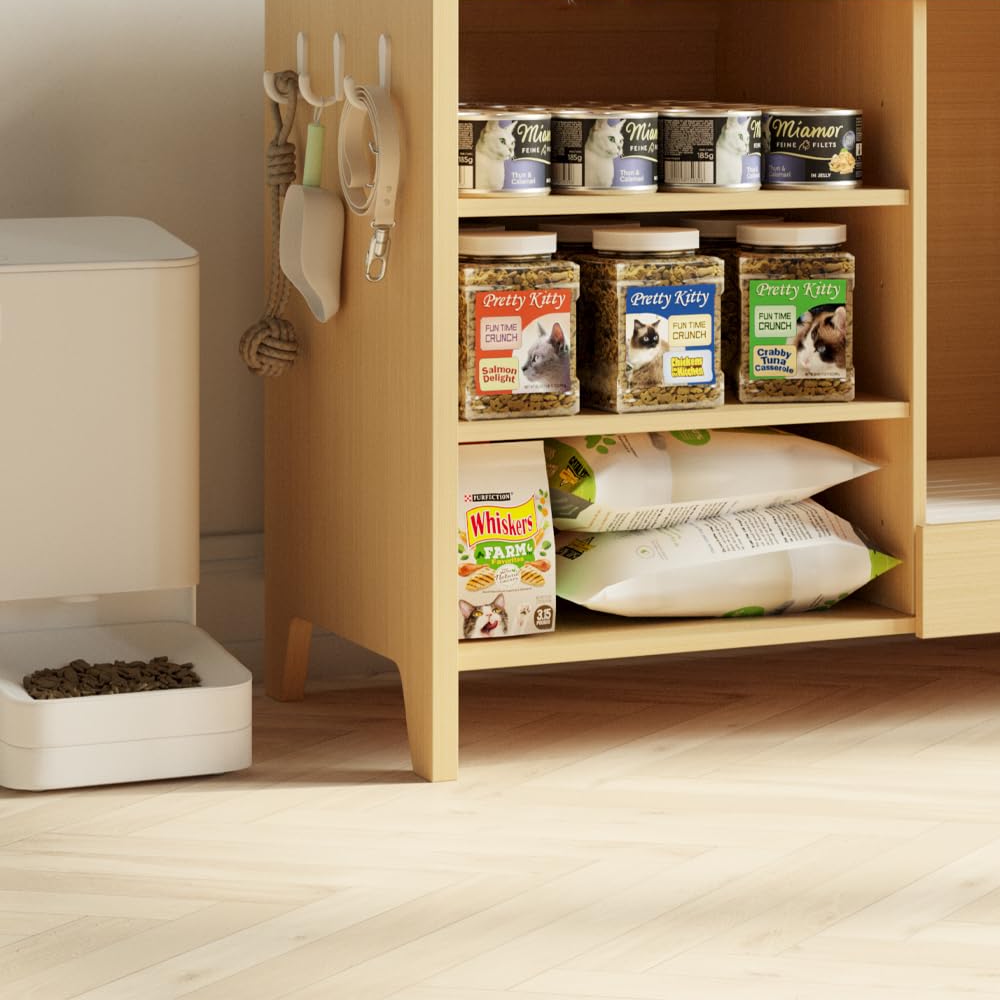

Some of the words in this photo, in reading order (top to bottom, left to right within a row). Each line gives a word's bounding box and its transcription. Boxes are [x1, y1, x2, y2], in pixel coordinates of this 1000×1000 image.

[772, 119, 844, 138] Miamor
[697, 151, 714, 161] 185g
[756, 282, 800, 301] Pretty
[803, 281, 841, 300] Kitty
[483, 293, 527, 312] Pretty
[529, 290, 566, 310] Kitty
[630, 291, 671, 310] Pretty
[674, 288, 710, 308] Kitty
[758, 312, 773, 320] FUN
[773, 312, 792, 320] TIME
[485, 324, 499, 333] FUN
[500, 323, 518, 332] TIME
[673, 321, 687, 330] FUN
[688, 320, 706, 329] TIME
[758, 321, 792, 331] CRUNCH
[485, 333, 518, 343] CRUNCH
[672, 330, 707, 340] CRUNCH
[757, 348, 792, 359] Crabby
[760, 355, 787, 366] Tuna
[482, 365, 517, 375] Salmon
[754, 364, 794, 374] Casserole
[483, 374, 516, 384] Delight
[470, 511, 534, 537] Whiskers
[483, 543, 527, 559] FARM
